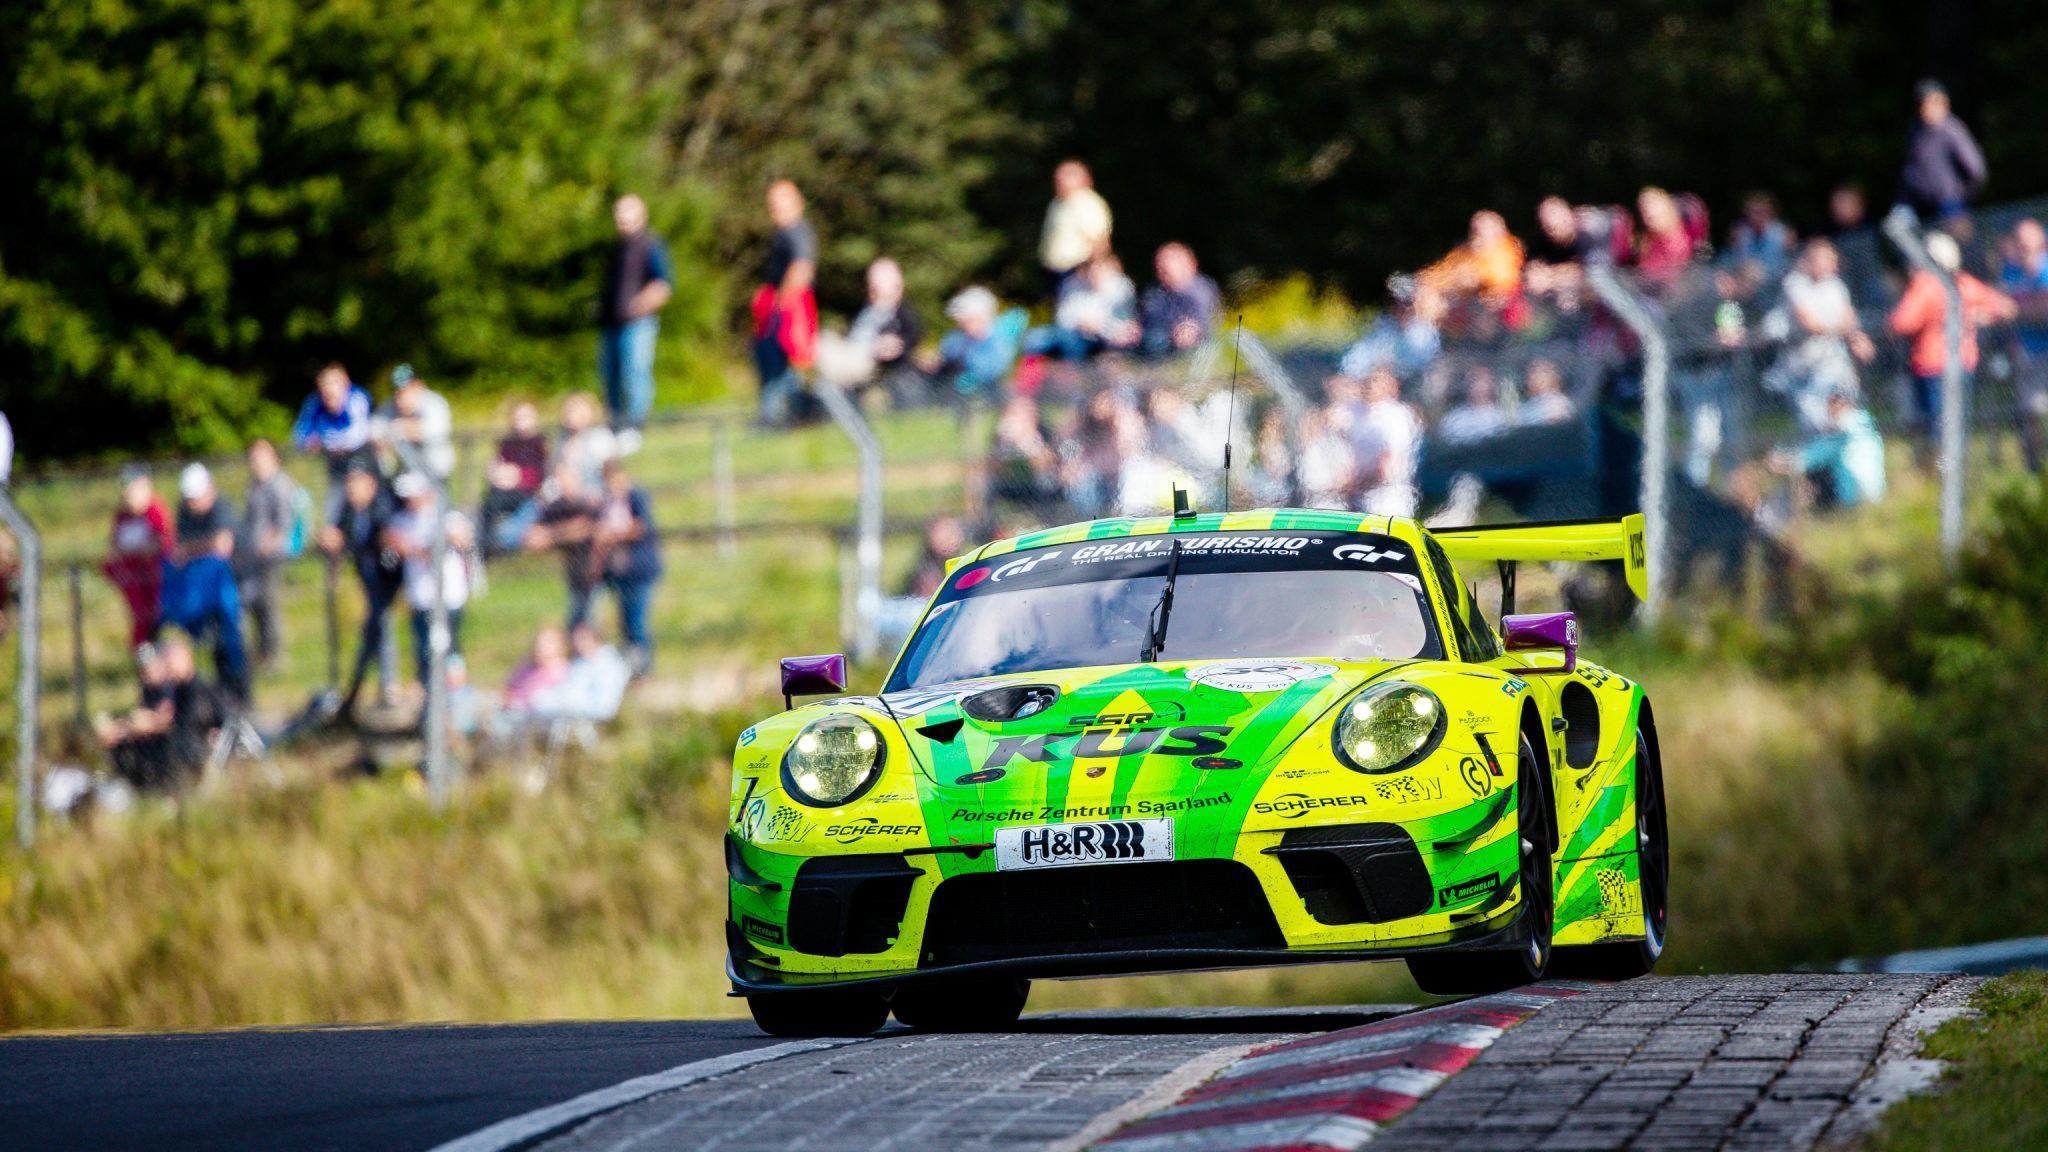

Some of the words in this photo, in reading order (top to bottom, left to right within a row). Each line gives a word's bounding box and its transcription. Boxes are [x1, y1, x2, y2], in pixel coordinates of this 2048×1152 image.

[1072, 539, 1164, 560] GRAN
[1072, 557, 1100, 566] THE
[1104, 552, 1142, 561] REAL
[1147, 549, 1208, 557] DRIING
[1212, 548, 1299, 556] SIMULATOR
[951, 808, 1034, 822] Porsche
[1038, 804, 1132, 820] Zentrum
[1138, 792, 1232, 813] Saarland
[1254, 796, 1368, 813] SCHERER
[825, 825, 922, 837] SCHERER
[1022, 825, 1101, 862] H&R
[1458, 878, 1497, 897] MICHELIN
